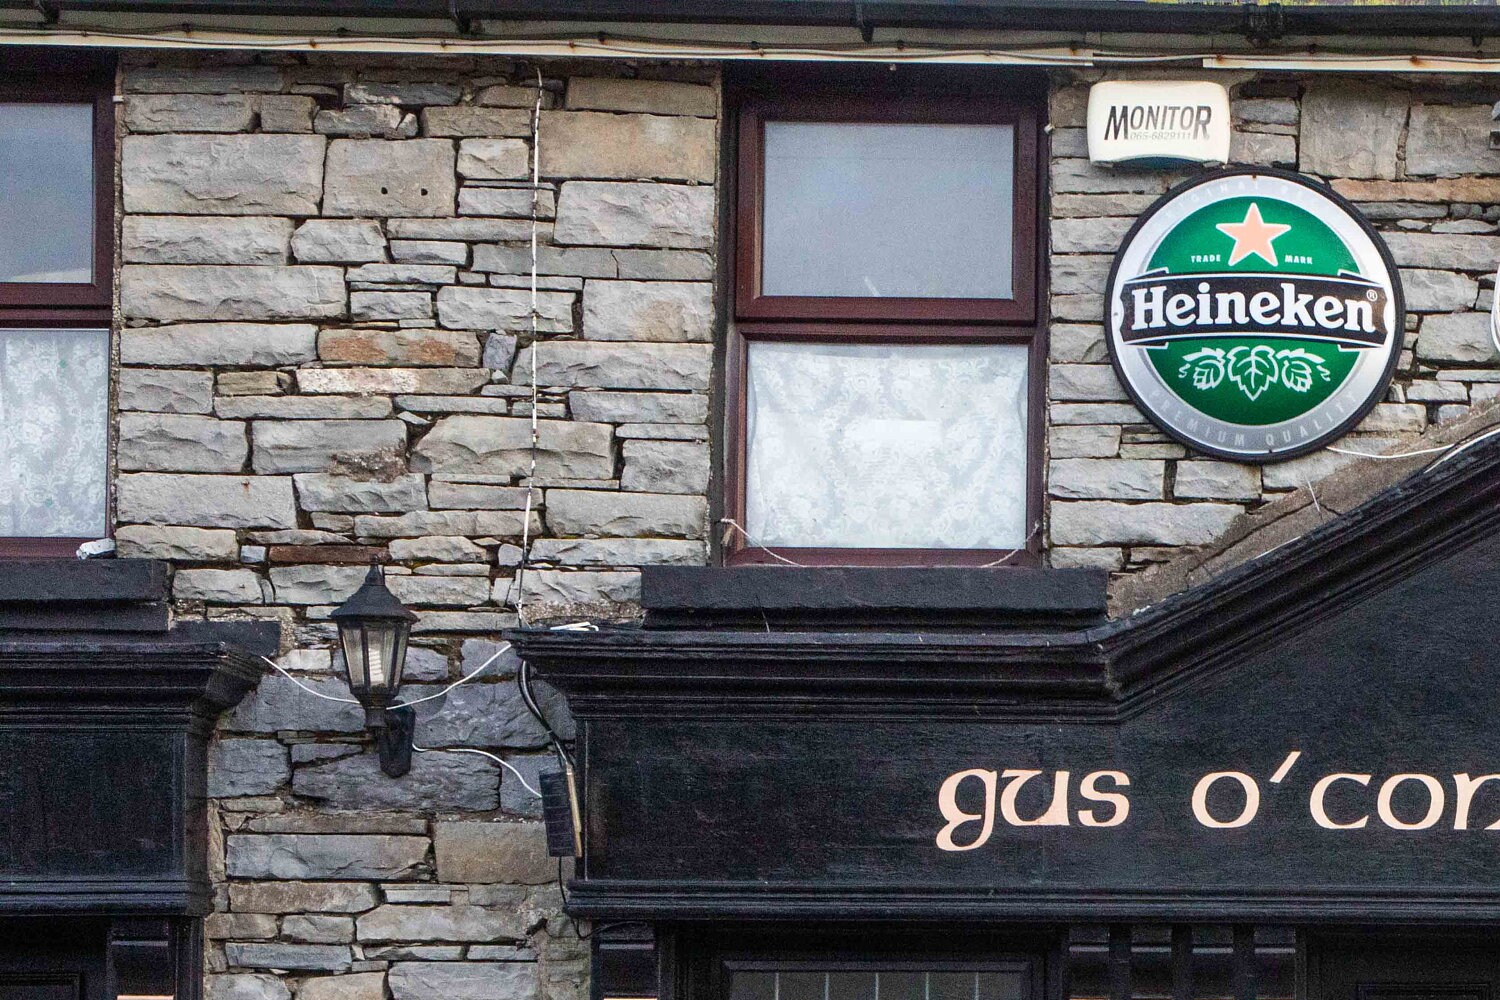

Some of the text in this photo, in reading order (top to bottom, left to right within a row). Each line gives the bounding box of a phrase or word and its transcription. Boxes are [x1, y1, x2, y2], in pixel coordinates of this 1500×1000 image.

[1104, 105, 1212, 140] MONITOR
[1190, 254, 1314, 265] TRADE MARK
[1131, 282, 1376, 334] Heineken
[1151, 389, 1357, 447] PREMIUM QUALITY
